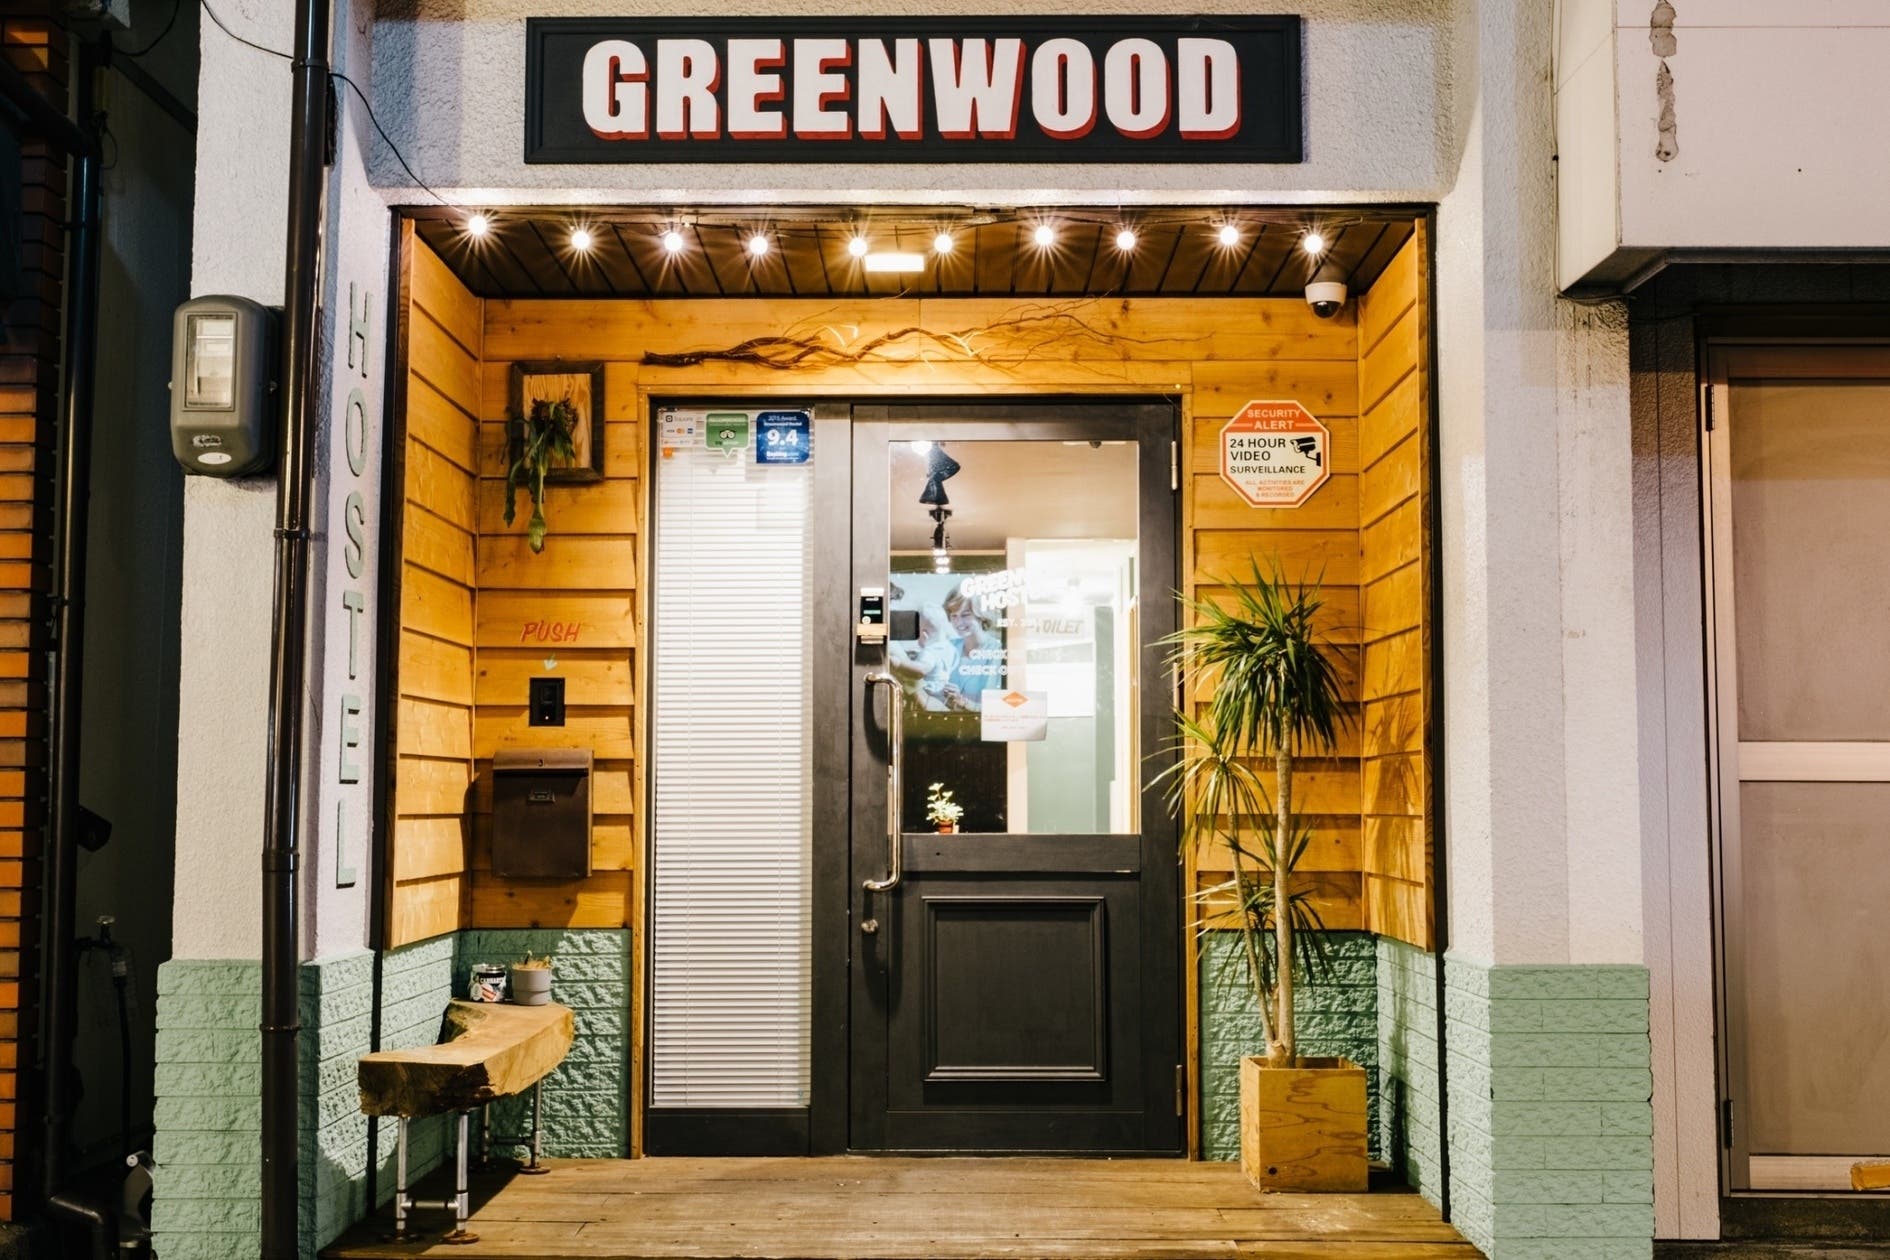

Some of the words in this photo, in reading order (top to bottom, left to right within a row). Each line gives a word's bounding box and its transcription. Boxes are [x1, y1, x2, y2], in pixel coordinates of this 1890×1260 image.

[581, 37, 1241, 141] GREENWOOD
[1247, 409, 1301, 418] SECURITY
[1254, 420, 1294, 430] ALERT
[767, 429, 798, 446] 9.4
[1230, 438, 1244, 448] 24
[1248, 438, 1286, 448] HOUR
[1230, 451, 1271, 461] VIDEO
[1230, 465, 1306, 474] SURVEILLANCE
[335, 280, 370, 889] HOSTEL
[520, 620, 581, 643] PUSH
[959, 665, 997, 675] CHECK
